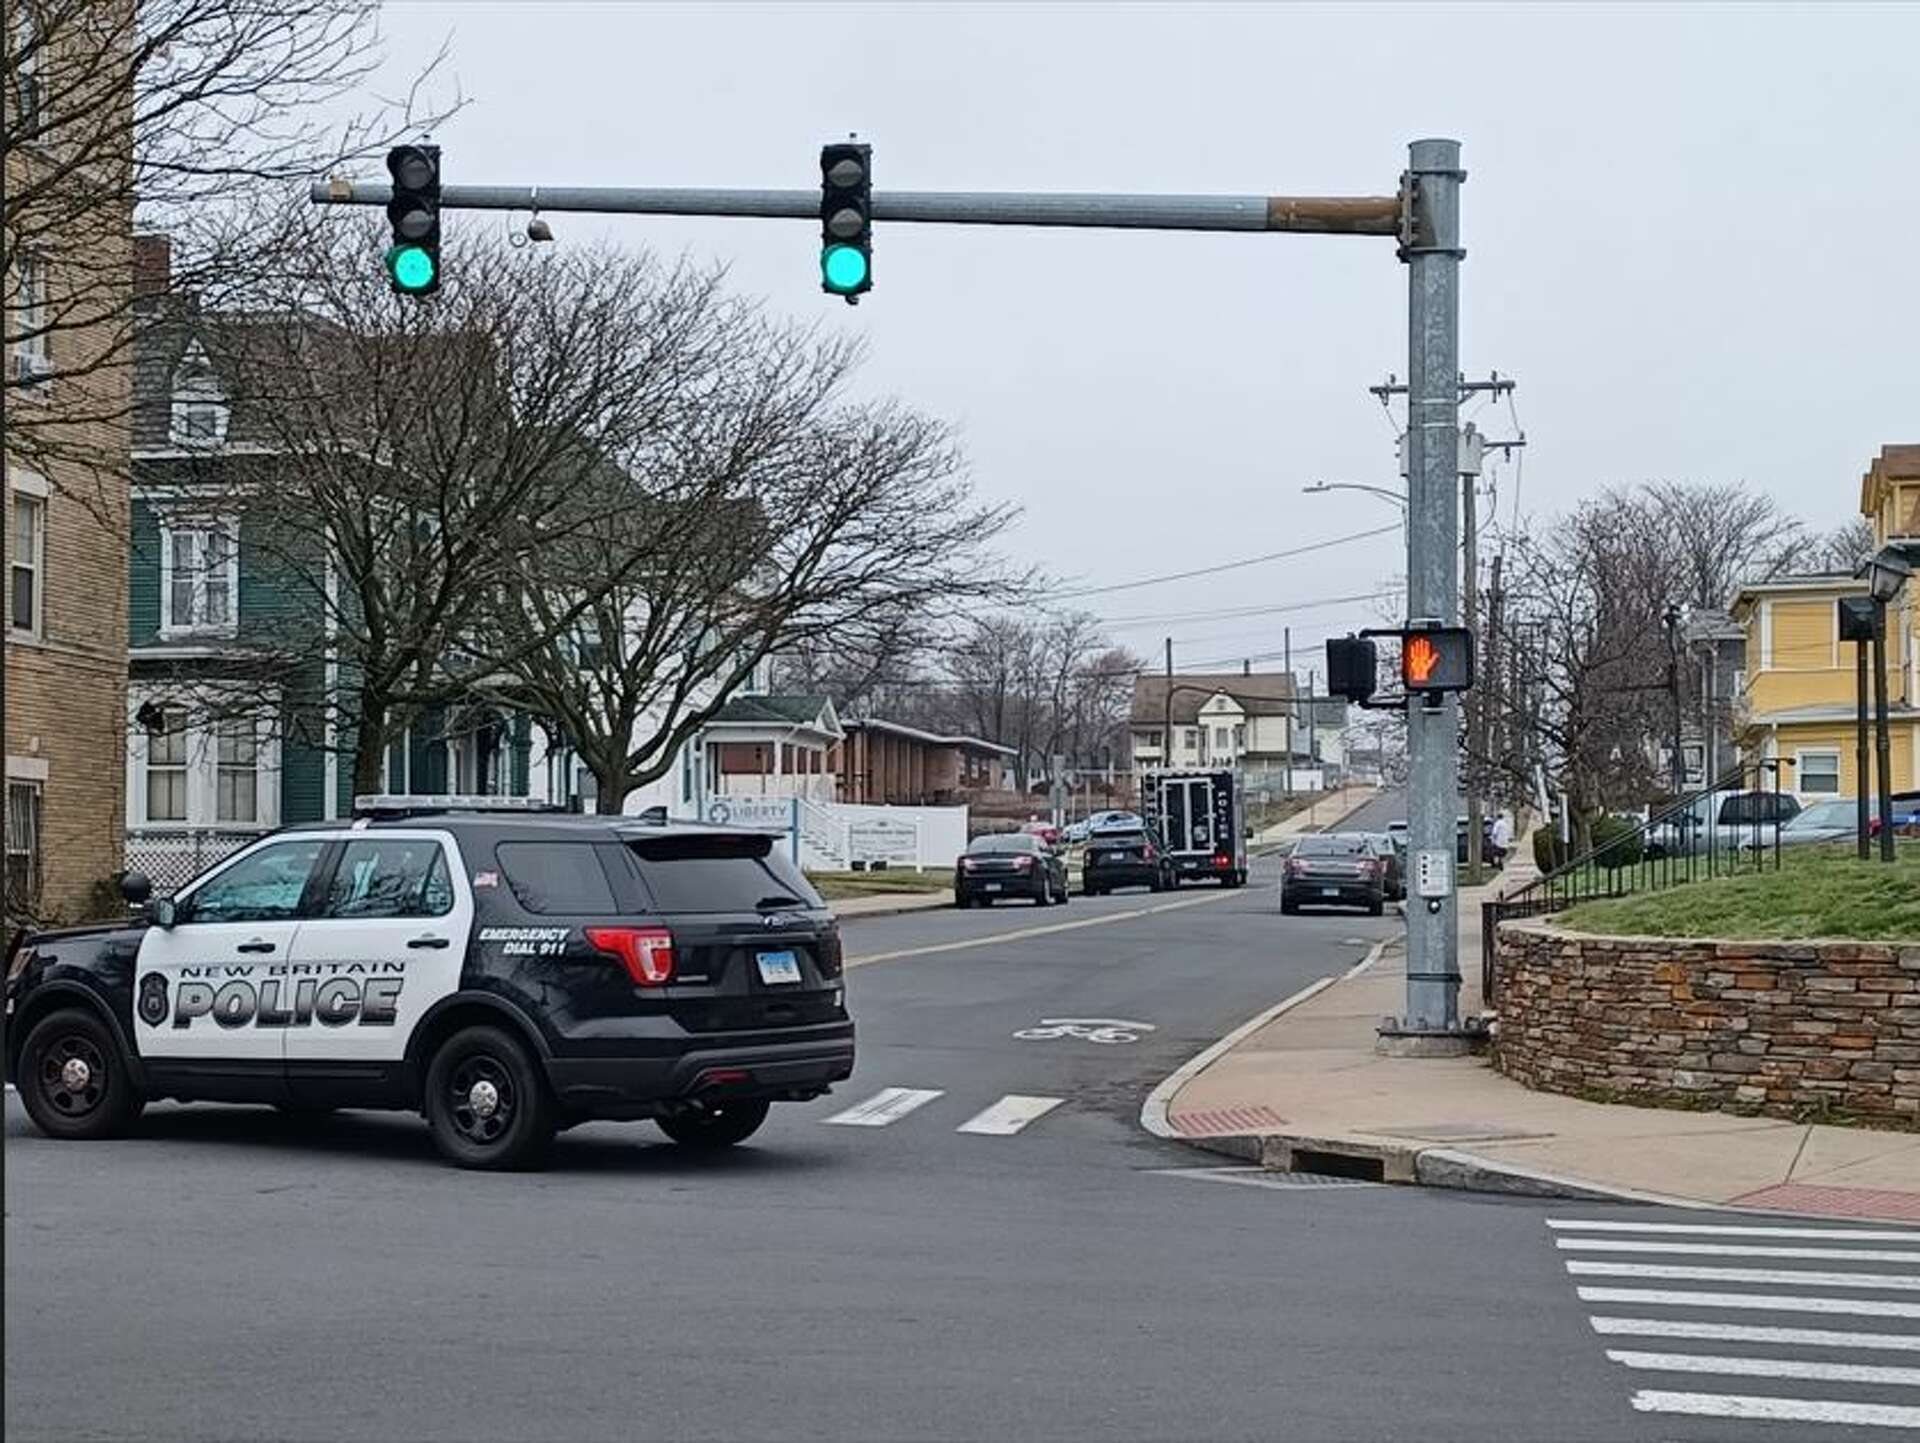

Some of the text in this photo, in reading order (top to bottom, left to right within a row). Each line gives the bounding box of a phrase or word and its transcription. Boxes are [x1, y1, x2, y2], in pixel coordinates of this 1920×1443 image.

[733, 806, 786, 817] LIBERTY
[479, 928, 570, 940] EMERGENCY
[503, 942, 567, 955] DIAL 911
[180, 962, 405, 978] NEW BRITAIN
[172, 977, 404, 1028] POLICE
